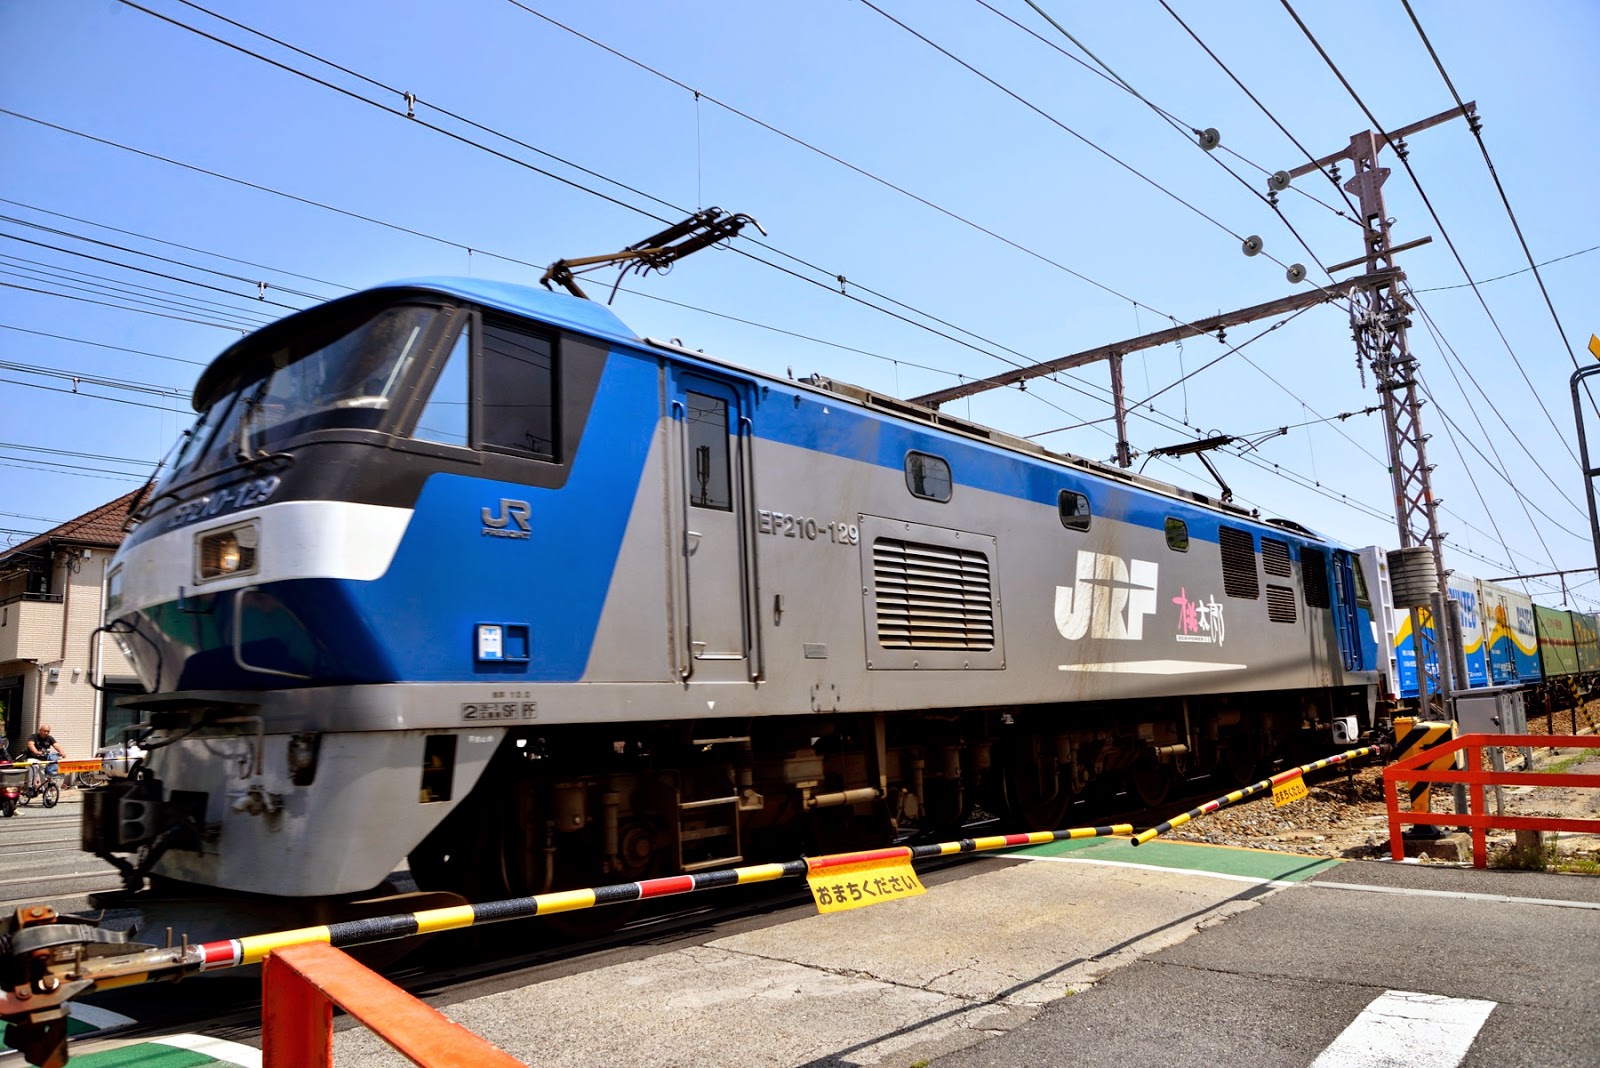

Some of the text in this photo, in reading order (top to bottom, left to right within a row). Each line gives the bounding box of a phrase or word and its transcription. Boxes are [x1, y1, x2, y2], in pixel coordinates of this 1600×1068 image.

[481, 498, 532, 530] JR
[758, 509, 859, 546] EF210-129
[1054, 550, 1159, 641] JRF
[1172, 586, 1225, 647] 桃太郎
[816, 875, 918, 906] おまちください
